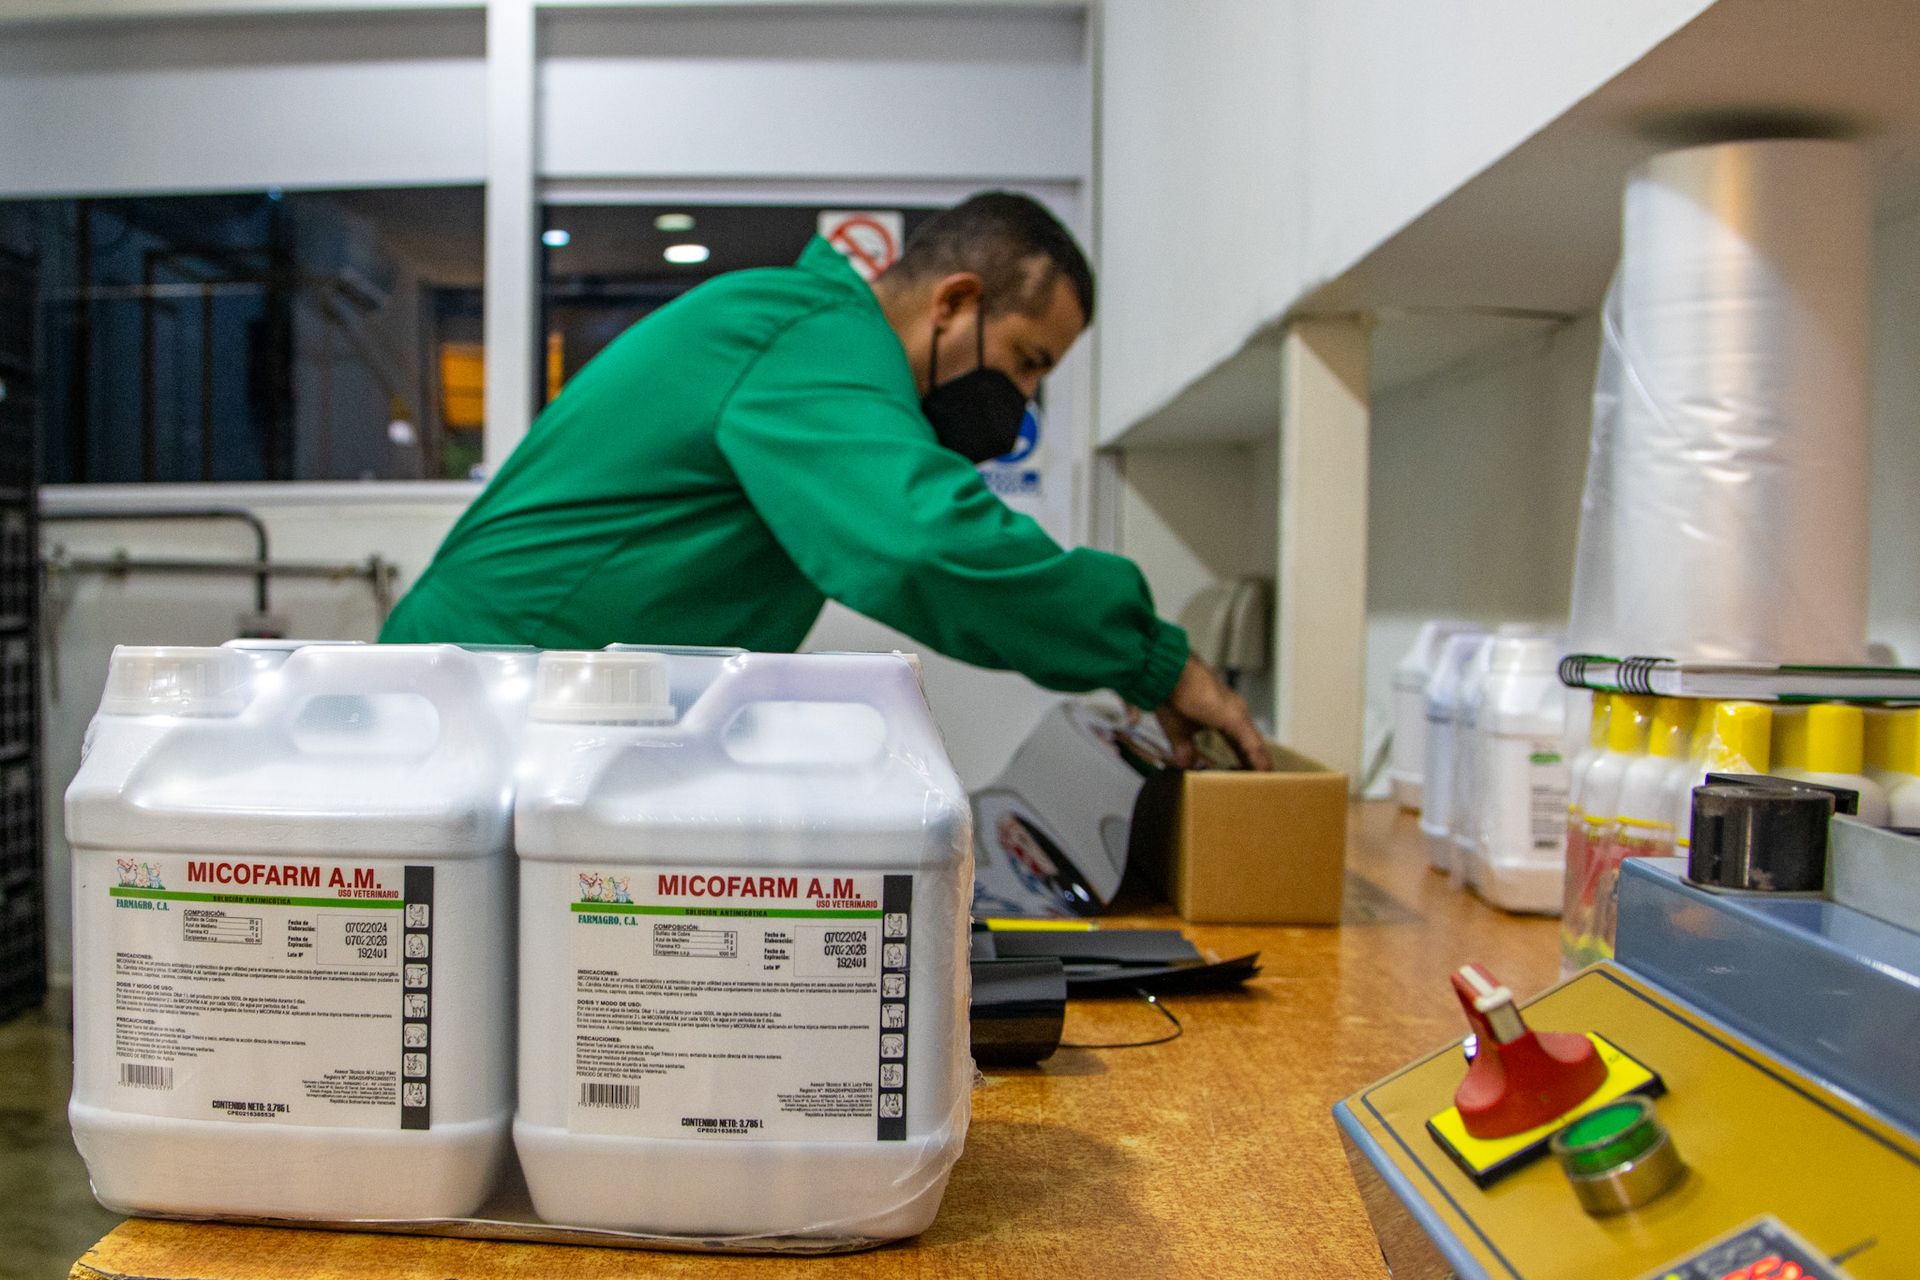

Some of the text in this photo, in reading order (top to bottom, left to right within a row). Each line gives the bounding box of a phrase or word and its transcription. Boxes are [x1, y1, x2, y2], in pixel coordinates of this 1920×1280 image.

[188, 862, 382, 889] MICOFARM A.M.
[658, 875, 861, 899] MICOFARM A.M.
[354, 890, 399, 898] VETERINARIO
[116, 899, 170, 911] FARMAGRO, C.A.
[816, 900, 878, 909] USO VETERINARIO
[578, 915, 638, 926] FARMAGRO, C.A.
[345, 922, 387, 933] 07022024
[824, 931, 867, 943] 07022024
[358, 948, 387, 959] 192401
[837, 958, 867, 968] 192401
[212, 1100, 246, 1110] CONTENIDO
[248, 1102, 265, 1111] NETO:
[286, 1104, 290, 1113] L
[682, 1118, 717, 1128] CONTENIDO
[719, 1119, 738, 1128] NETO:
[759, 1119, 764, 1128] L
